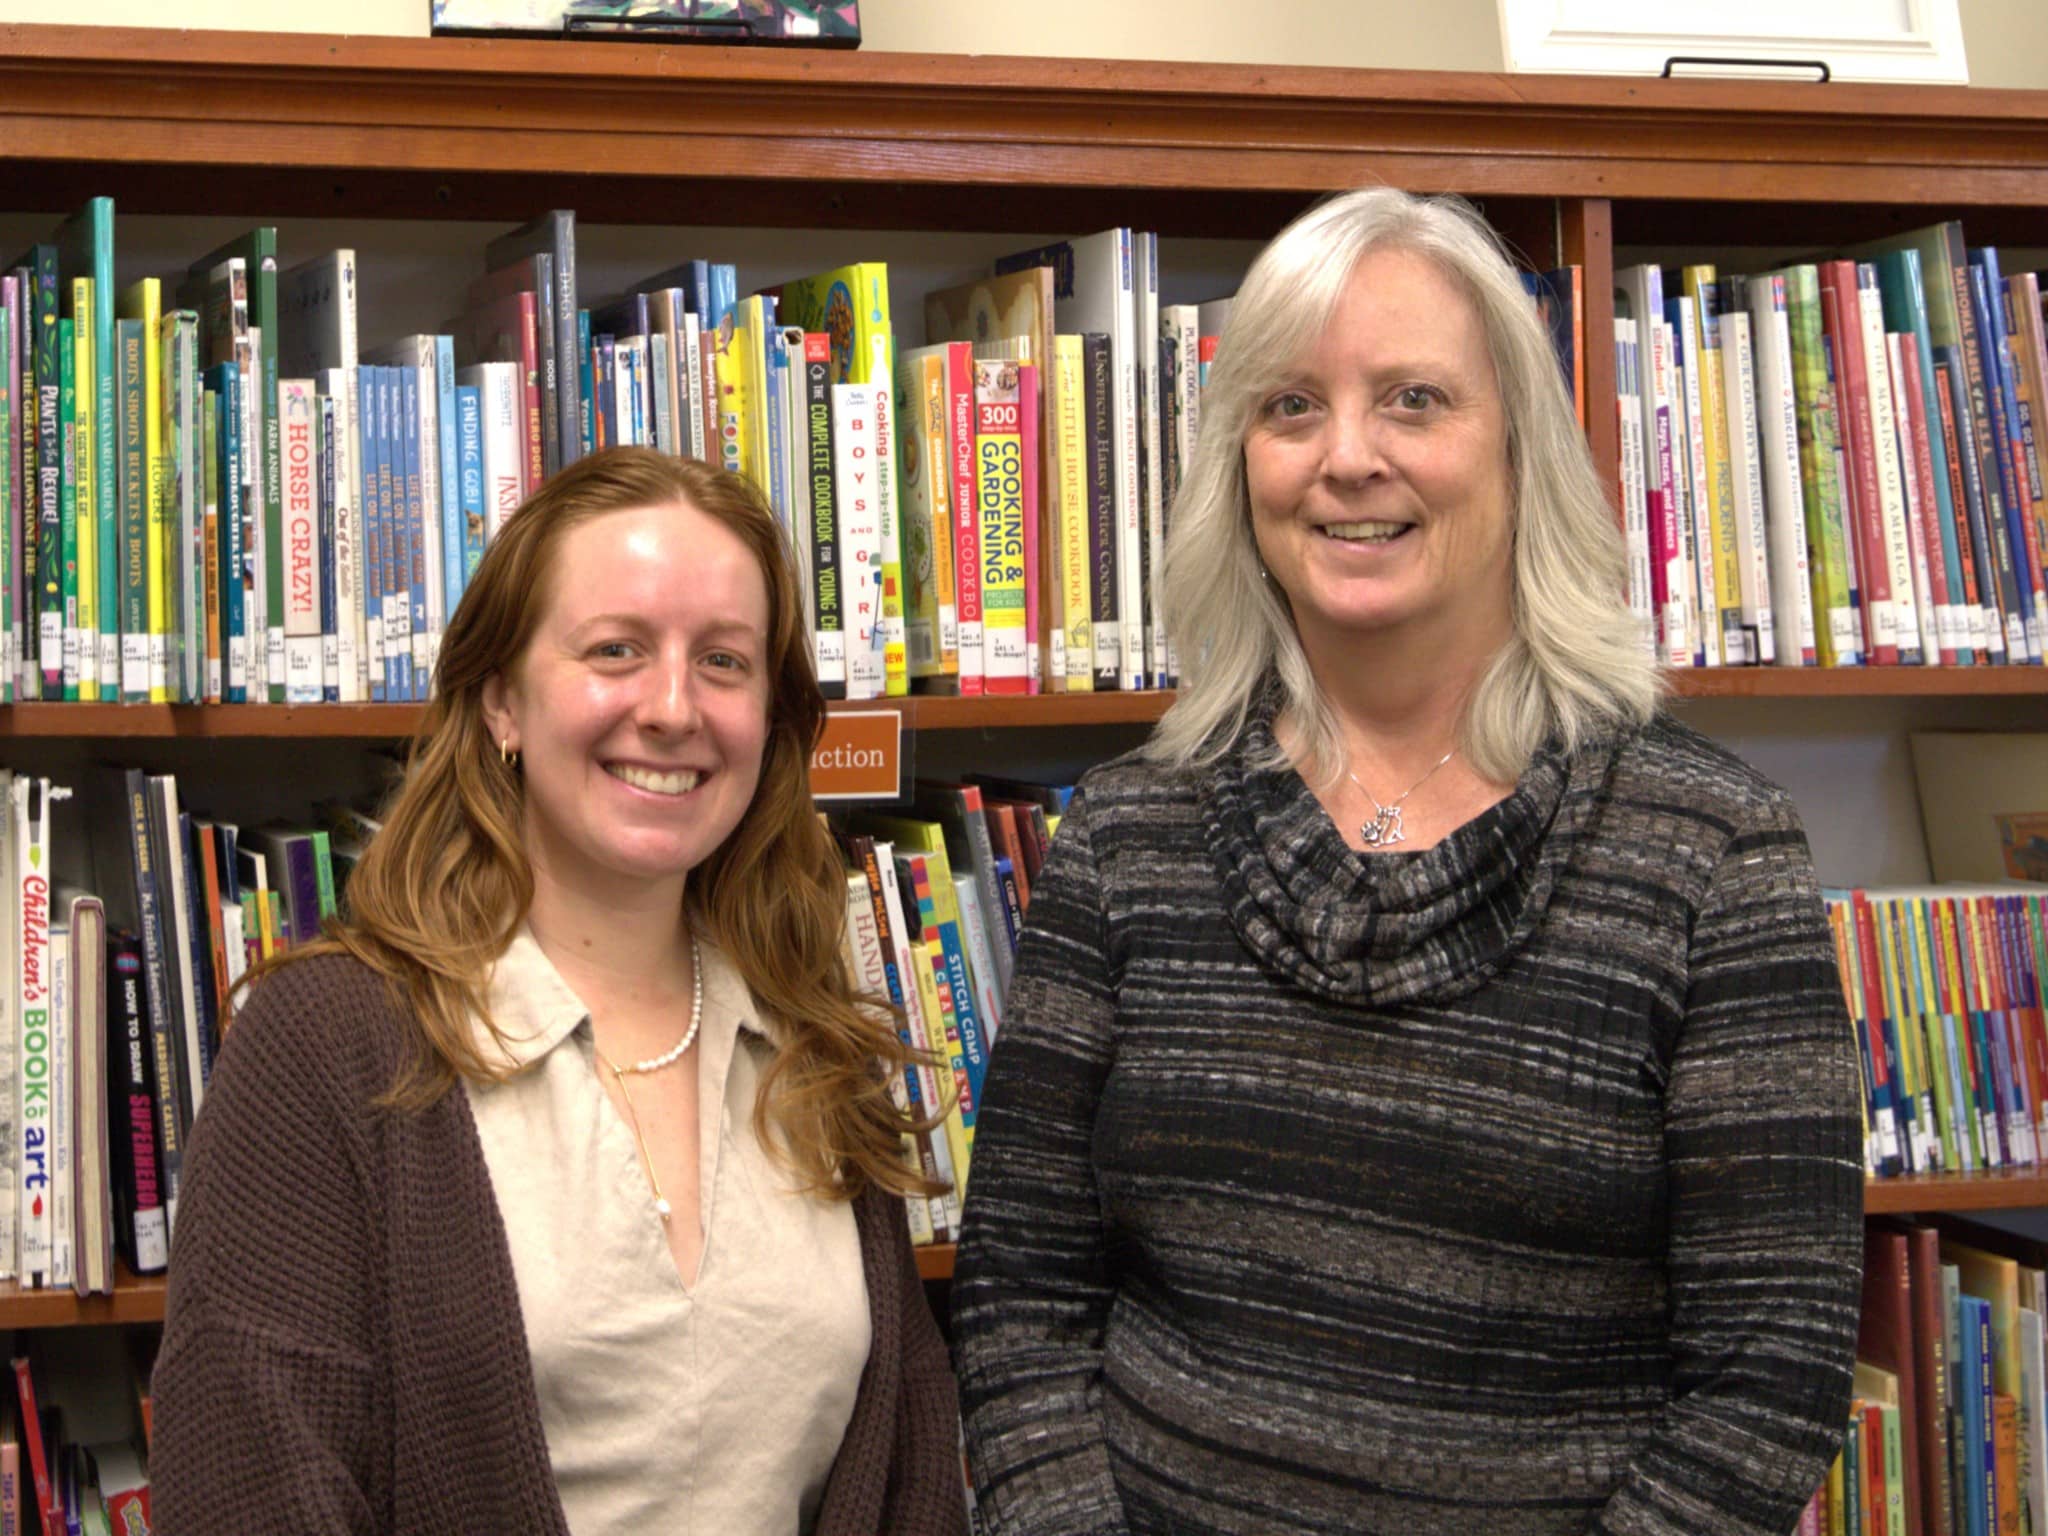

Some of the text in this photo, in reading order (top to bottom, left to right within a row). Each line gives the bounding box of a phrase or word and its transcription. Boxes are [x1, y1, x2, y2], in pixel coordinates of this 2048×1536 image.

[559, 271, 572, 320] DOGS
[1954, 265, 1973, 336] NATIONAL
[1965, 338, 1981, 384] PARKS
[547, 359, 555, 390] DOGS
[813, 385, 824, 400] THE
[102, 374, 114, 521] MY BACKYARD GARDEN
[267, 419, 278, 449] FARM
[463, 395, 480, 504] FINDING GOBI
[810, 404, 831, 470] COMPLETE
[982, 406, 1017, 425] 300
[1063, 397, 1076, 453] LITTLE
[1783, 401, 1796, 460] America
[22, 371, 37, 576] THE GREAT YELLOWSTONE FIRE
[41, 385, 60, 523] PLANTS RESCUE!
[127, 338, 142, 586] ROOTS SHOOTS BUCKETS BOOTS
[268, 452, 279, 505] ANIMALS
[365, 473, 377, 496] LIFE
[379, 463, 391, 487] LIFE
[392, 476, 404, 498] LIFE
[408, 475, 420, 497] LIFE
[875, 391, 893, 537] Cooking step-by-step
[1065, 458, 1078, 512] HOUSE
[289, 423, 313, 613] HORSE CRAZY!
[366, 501, 378, 517] ON
[380, 491, 392, 507] ON
[393, 503, 405, 519] ON
[409, 502, 421, 518] ON
[813, 474, 834, 543] COOKBOOK
[956, 393, 976, 620] MasterChef JUNIOR COOKBO
[982, 442, 1004, 585] GARDENING
[1002, 441, 1023, 582] COOKING &
[1718, 462, 1735, 552] PRESIDENTS
[1747, 463, 1763, 549] PRESIDENTS
[1068, 516, 1083, 609] COOKBOOK
[1889, 502, 1908, 588] AMERICA
[819, 567, 837, 610] YOUNG
[23, 874, 49, 1002] Children's
[855, 913, 884, 986] HAND
[125, 979, 143, 1083] HOW TO DRAW
[936, 970, 958, 1040] CRAFT
[948, 953, 980, 1064] STITCH CAMP
[24, 1009, 48, 1104] BOOK
[155, 1032, 171, 1099] MEDIEVAL
[24, 1126, 51, 1190] art
[162, 1105, 176, 1151] CASTLE
